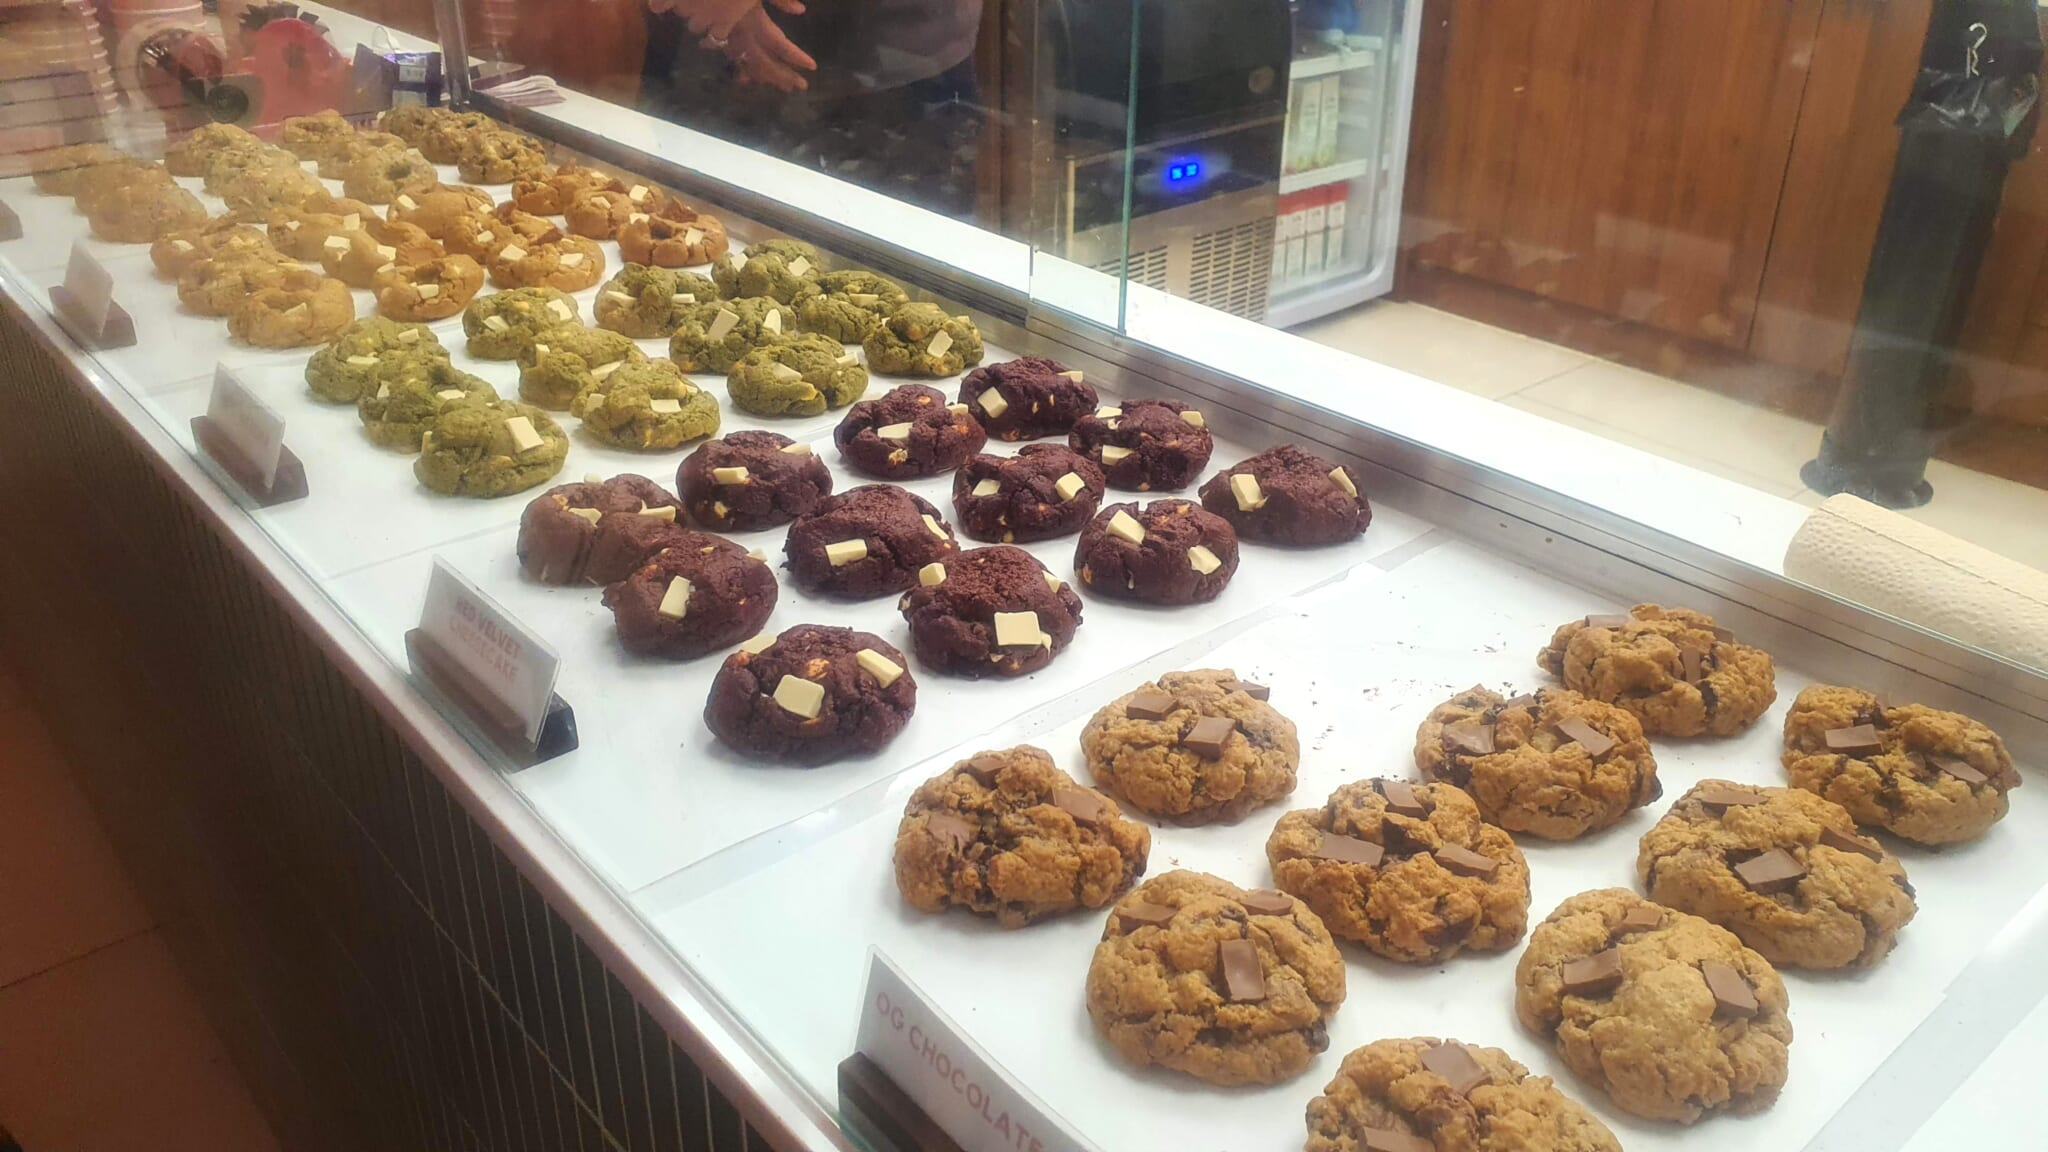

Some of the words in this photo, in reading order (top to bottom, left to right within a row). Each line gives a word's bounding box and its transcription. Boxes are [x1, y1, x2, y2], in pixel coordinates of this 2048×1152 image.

[455, 596, 476, 622] RED
[478, 616, 521, 659] VELVET
[876, 992, 904, 1030] OG
